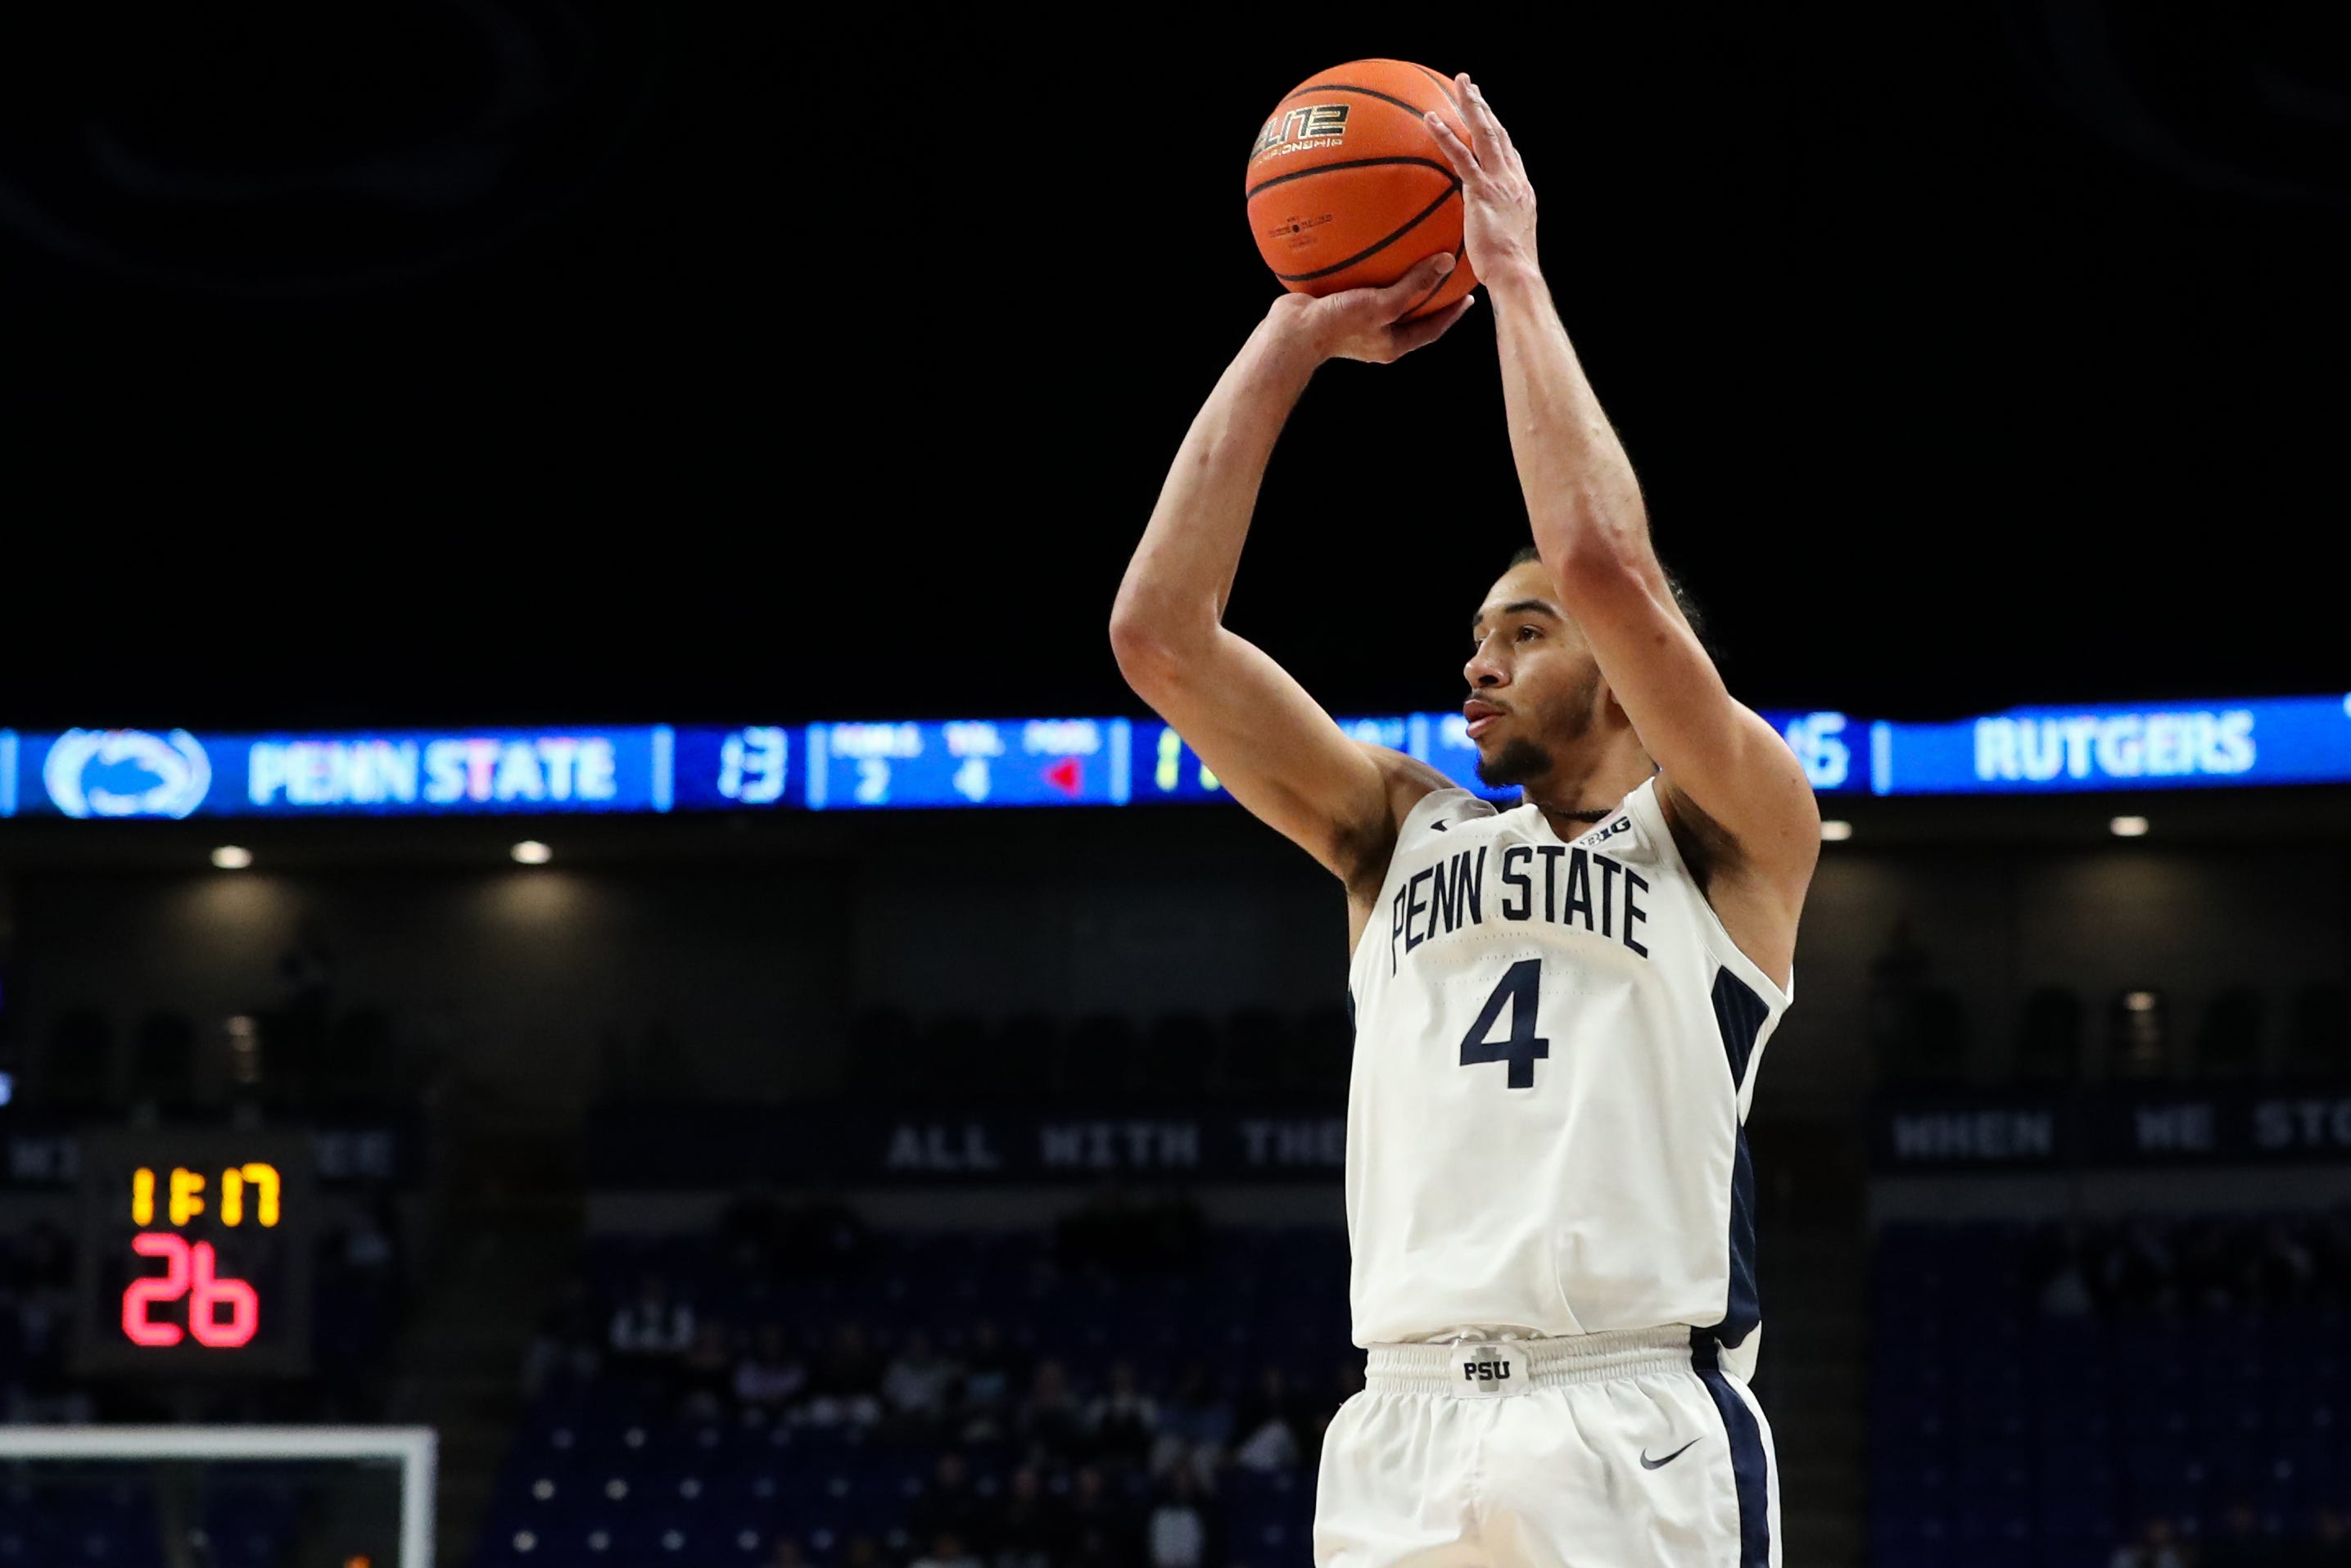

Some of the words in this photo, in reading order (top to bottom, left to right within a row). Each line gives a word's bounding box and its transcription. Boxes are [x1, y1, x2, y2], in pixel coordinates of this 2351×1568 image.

[248, 740, 420, 805] PENN
[424, 739, 617, 802] STATE
[1973, 710, 2255, 781] RUTGERS
[1391, 846, 1487, 978] PENN
[1502, 845, 1649, 959] STATE
[1459, 958, 1549, 1089] 4
[887, 1123, 1002, 1171] ALL
[1038, 1119, 1201, 1168] WITH
[121, 1231, 260, 1348] 26
[1463, 1361, 1510, 1380] PSU
